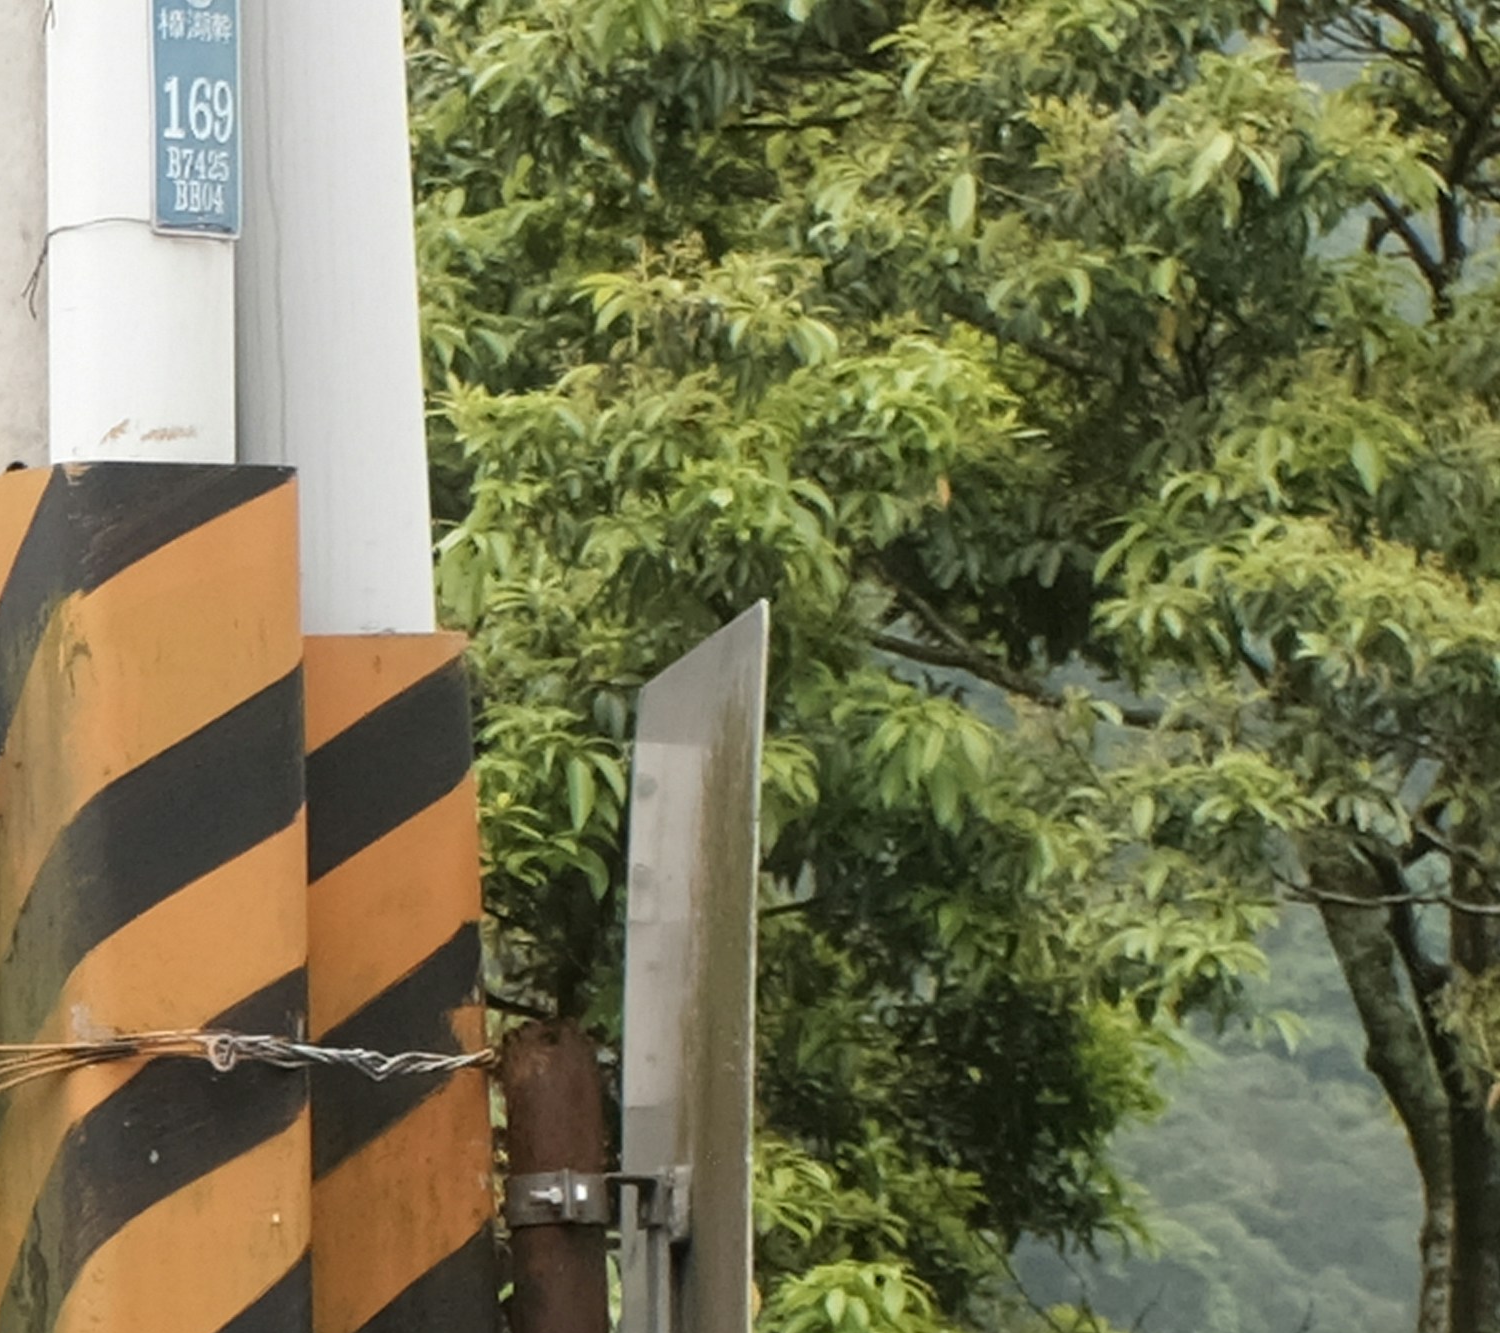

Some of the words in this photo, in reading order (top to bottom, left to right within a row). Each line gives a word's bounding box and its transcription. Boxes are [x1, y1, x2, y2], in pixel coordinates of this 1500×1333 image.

[163, 75, 234, 142] 169
[166, 146, 230, 181] B7425
[174, 180, 224, 214] BB04
